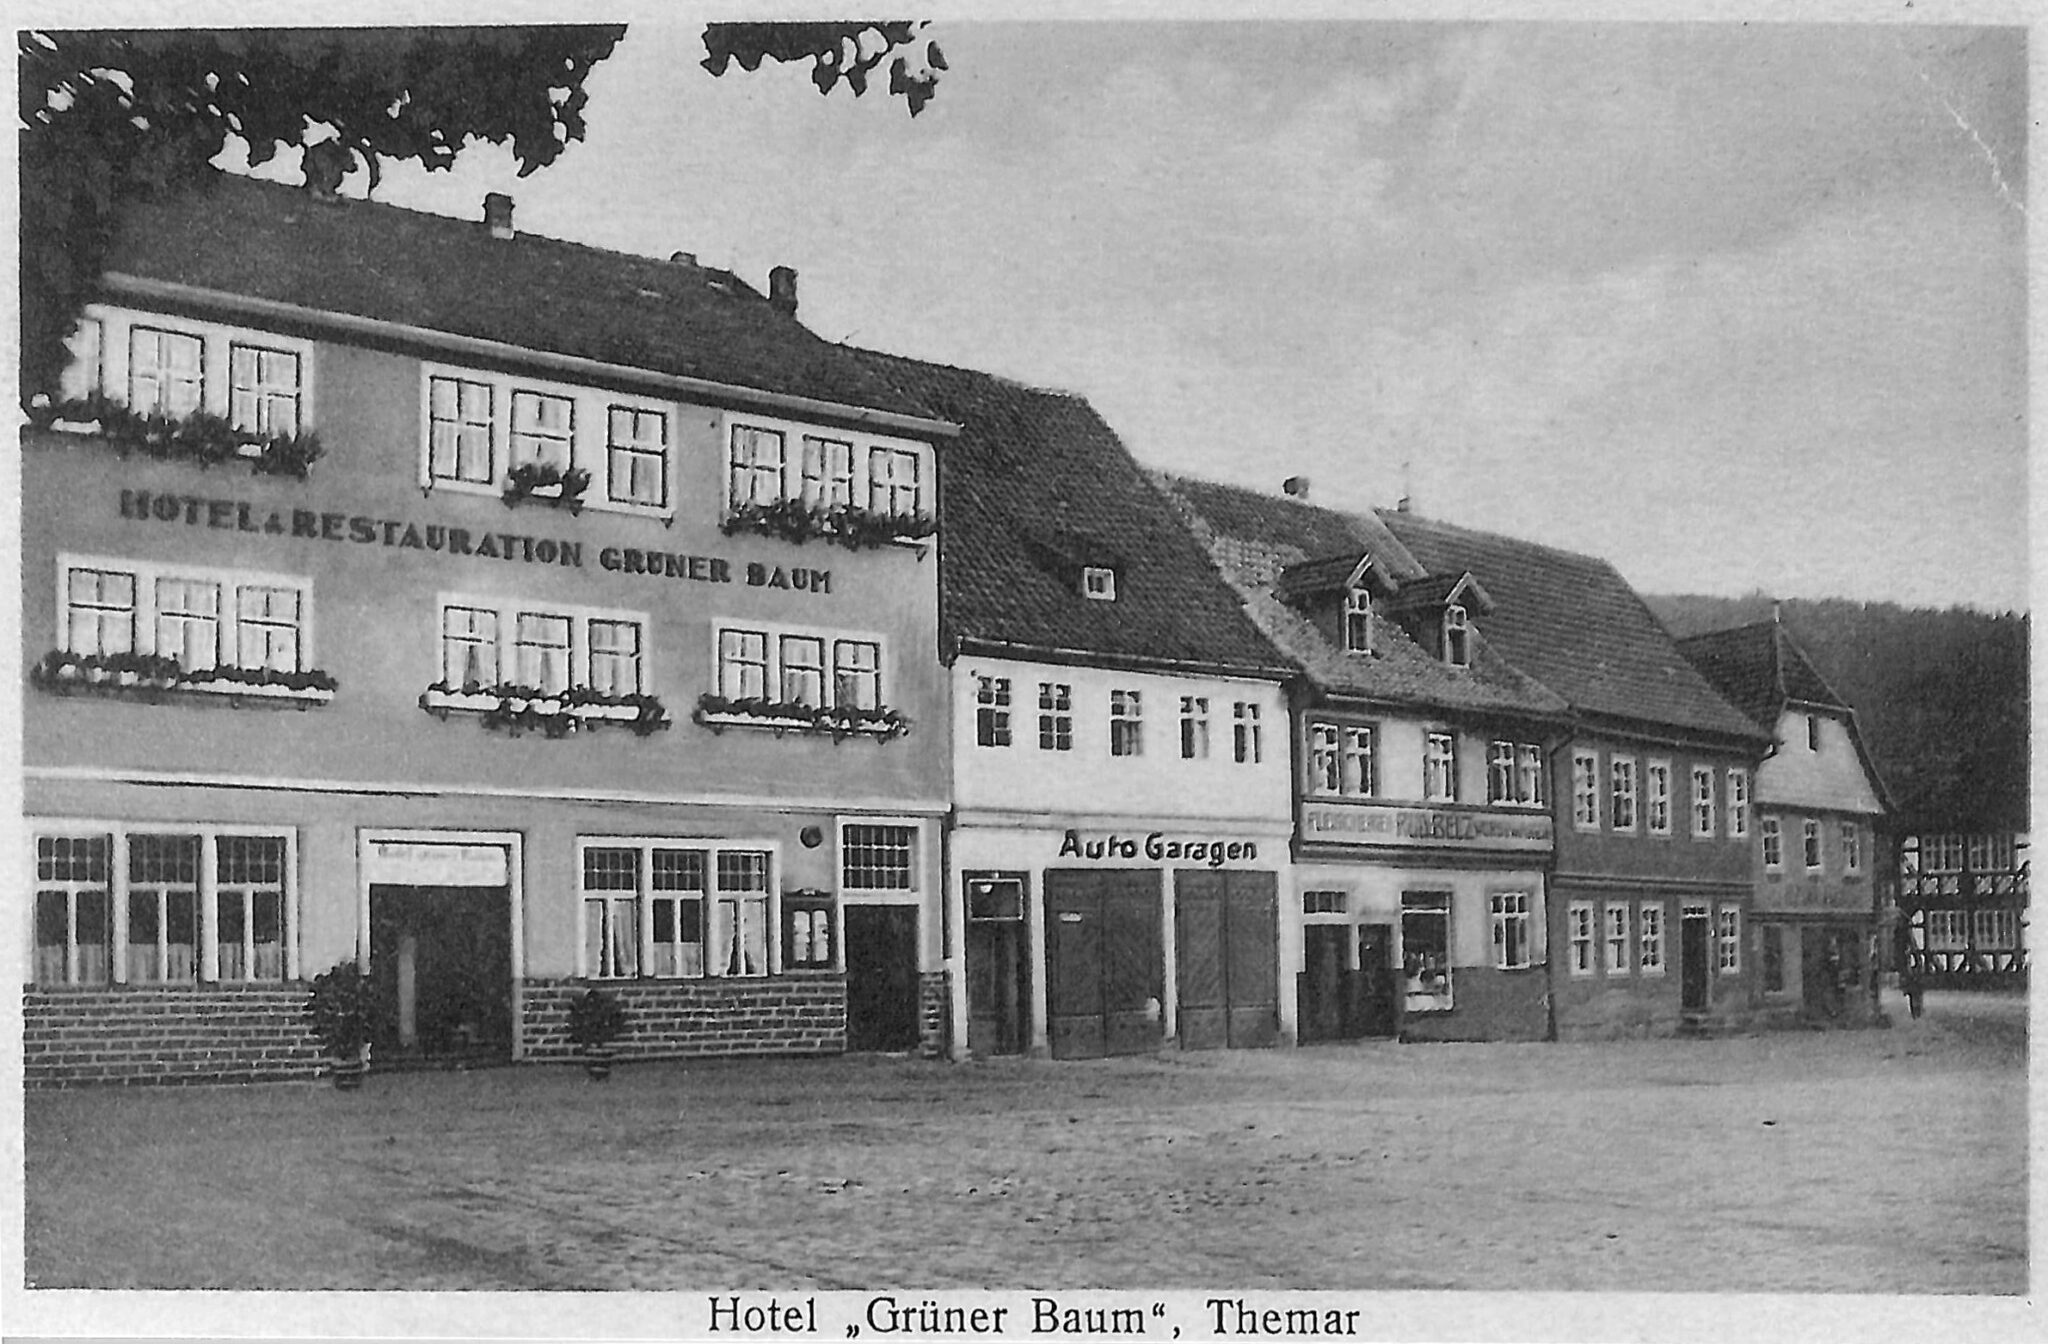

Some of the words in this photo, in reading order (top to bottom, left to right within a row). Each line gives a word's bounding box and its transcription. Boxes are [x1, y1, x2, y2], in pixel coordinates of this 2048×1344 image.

[120, 489, 259, 533] HOTEL
[292, 508, 583, 567] RESTAURATION
[746, 561, 831, 594] BAUM
[1059, 829, 1138, 859] Auto
[1145, 832, 1257, 867] Garagen
